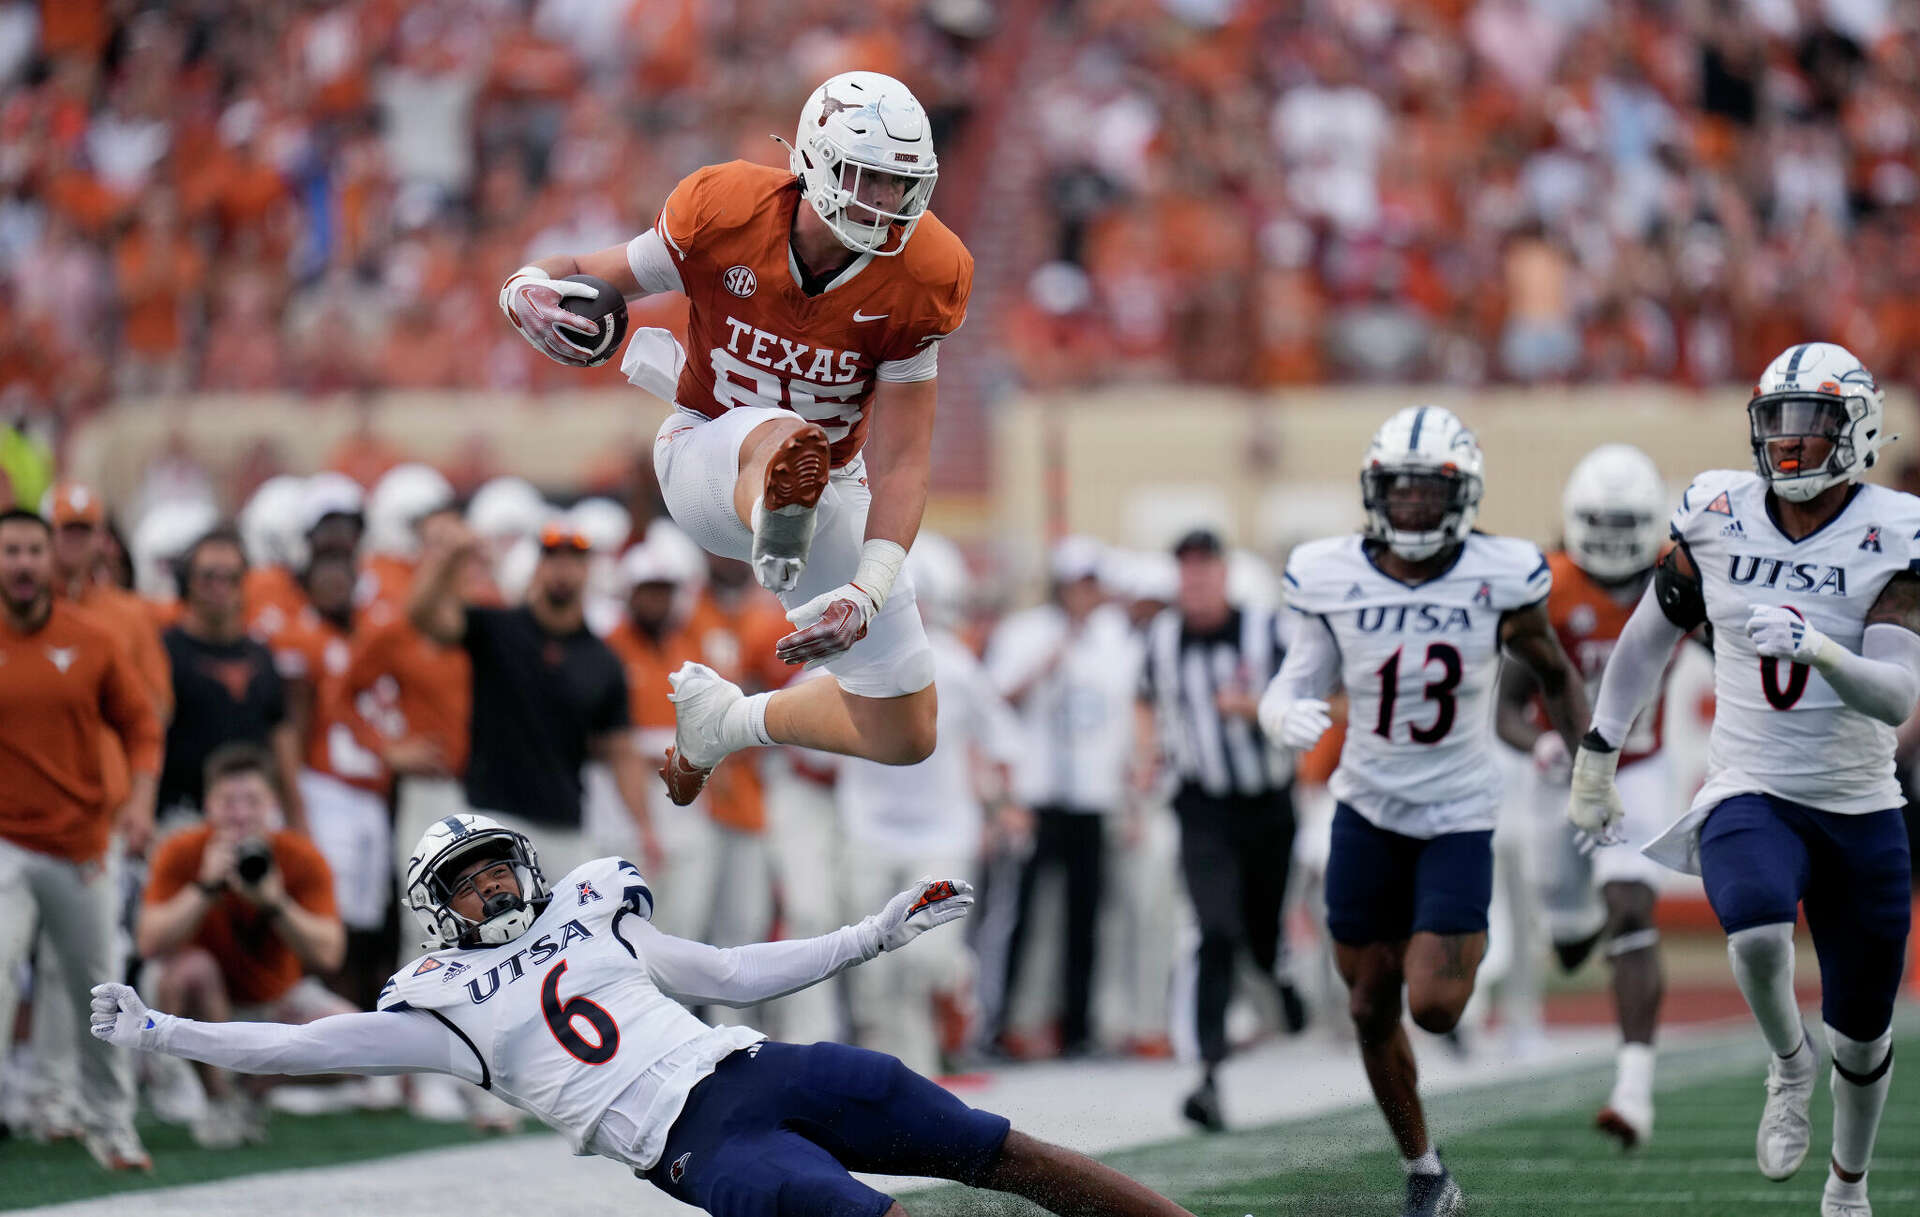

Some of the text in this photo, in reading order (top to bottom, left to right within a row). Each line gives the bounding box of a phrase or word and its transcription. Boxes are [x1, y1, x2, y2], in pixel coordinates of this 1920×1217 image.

[726, 268, 755, 295] SEC
[725, 315, 861, 383] TEXAS
[710, 348, 866, 444] 85
[1728, 554, 1847, 597] UTSA
[1355, 603, 1472, 633] UTSA
[1373, 642, 1462, 745] 13
[441, 963, 472, 984] adidas
[463, 919, 594, 1004] UTSA
[540, 958, 620, 1066] 6
